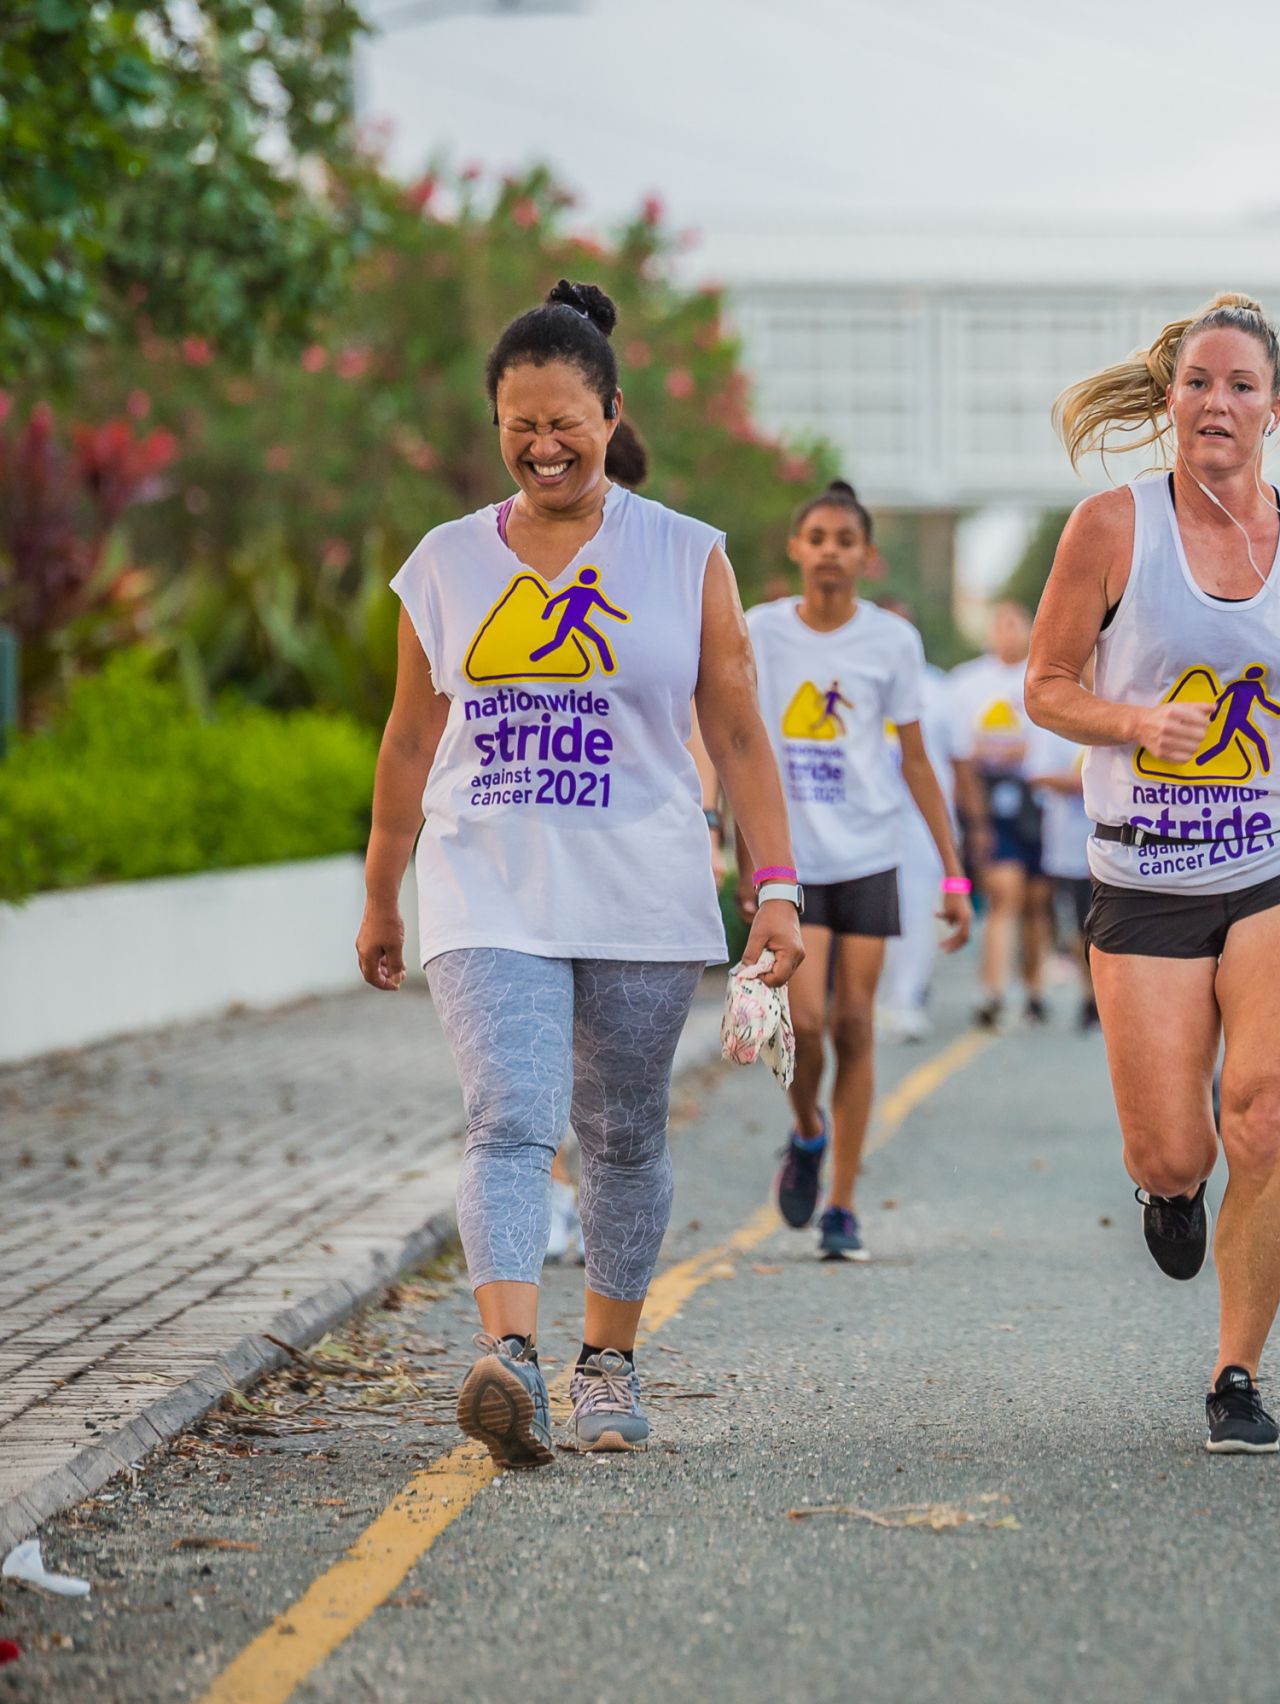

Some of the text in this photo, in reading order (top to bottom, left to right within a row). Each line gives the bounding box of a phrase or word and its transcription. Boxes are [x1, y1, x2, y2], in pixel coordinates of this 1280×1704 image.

[464, 688, 610, 721] nationwide
[474, 712, 613, 767] stride
[471, 767, 532, 790] against
[535, 768, 611, 808] 2021
[470, 788, 533, 806] cancer
[1139, 853, 1205, 876] cancer
